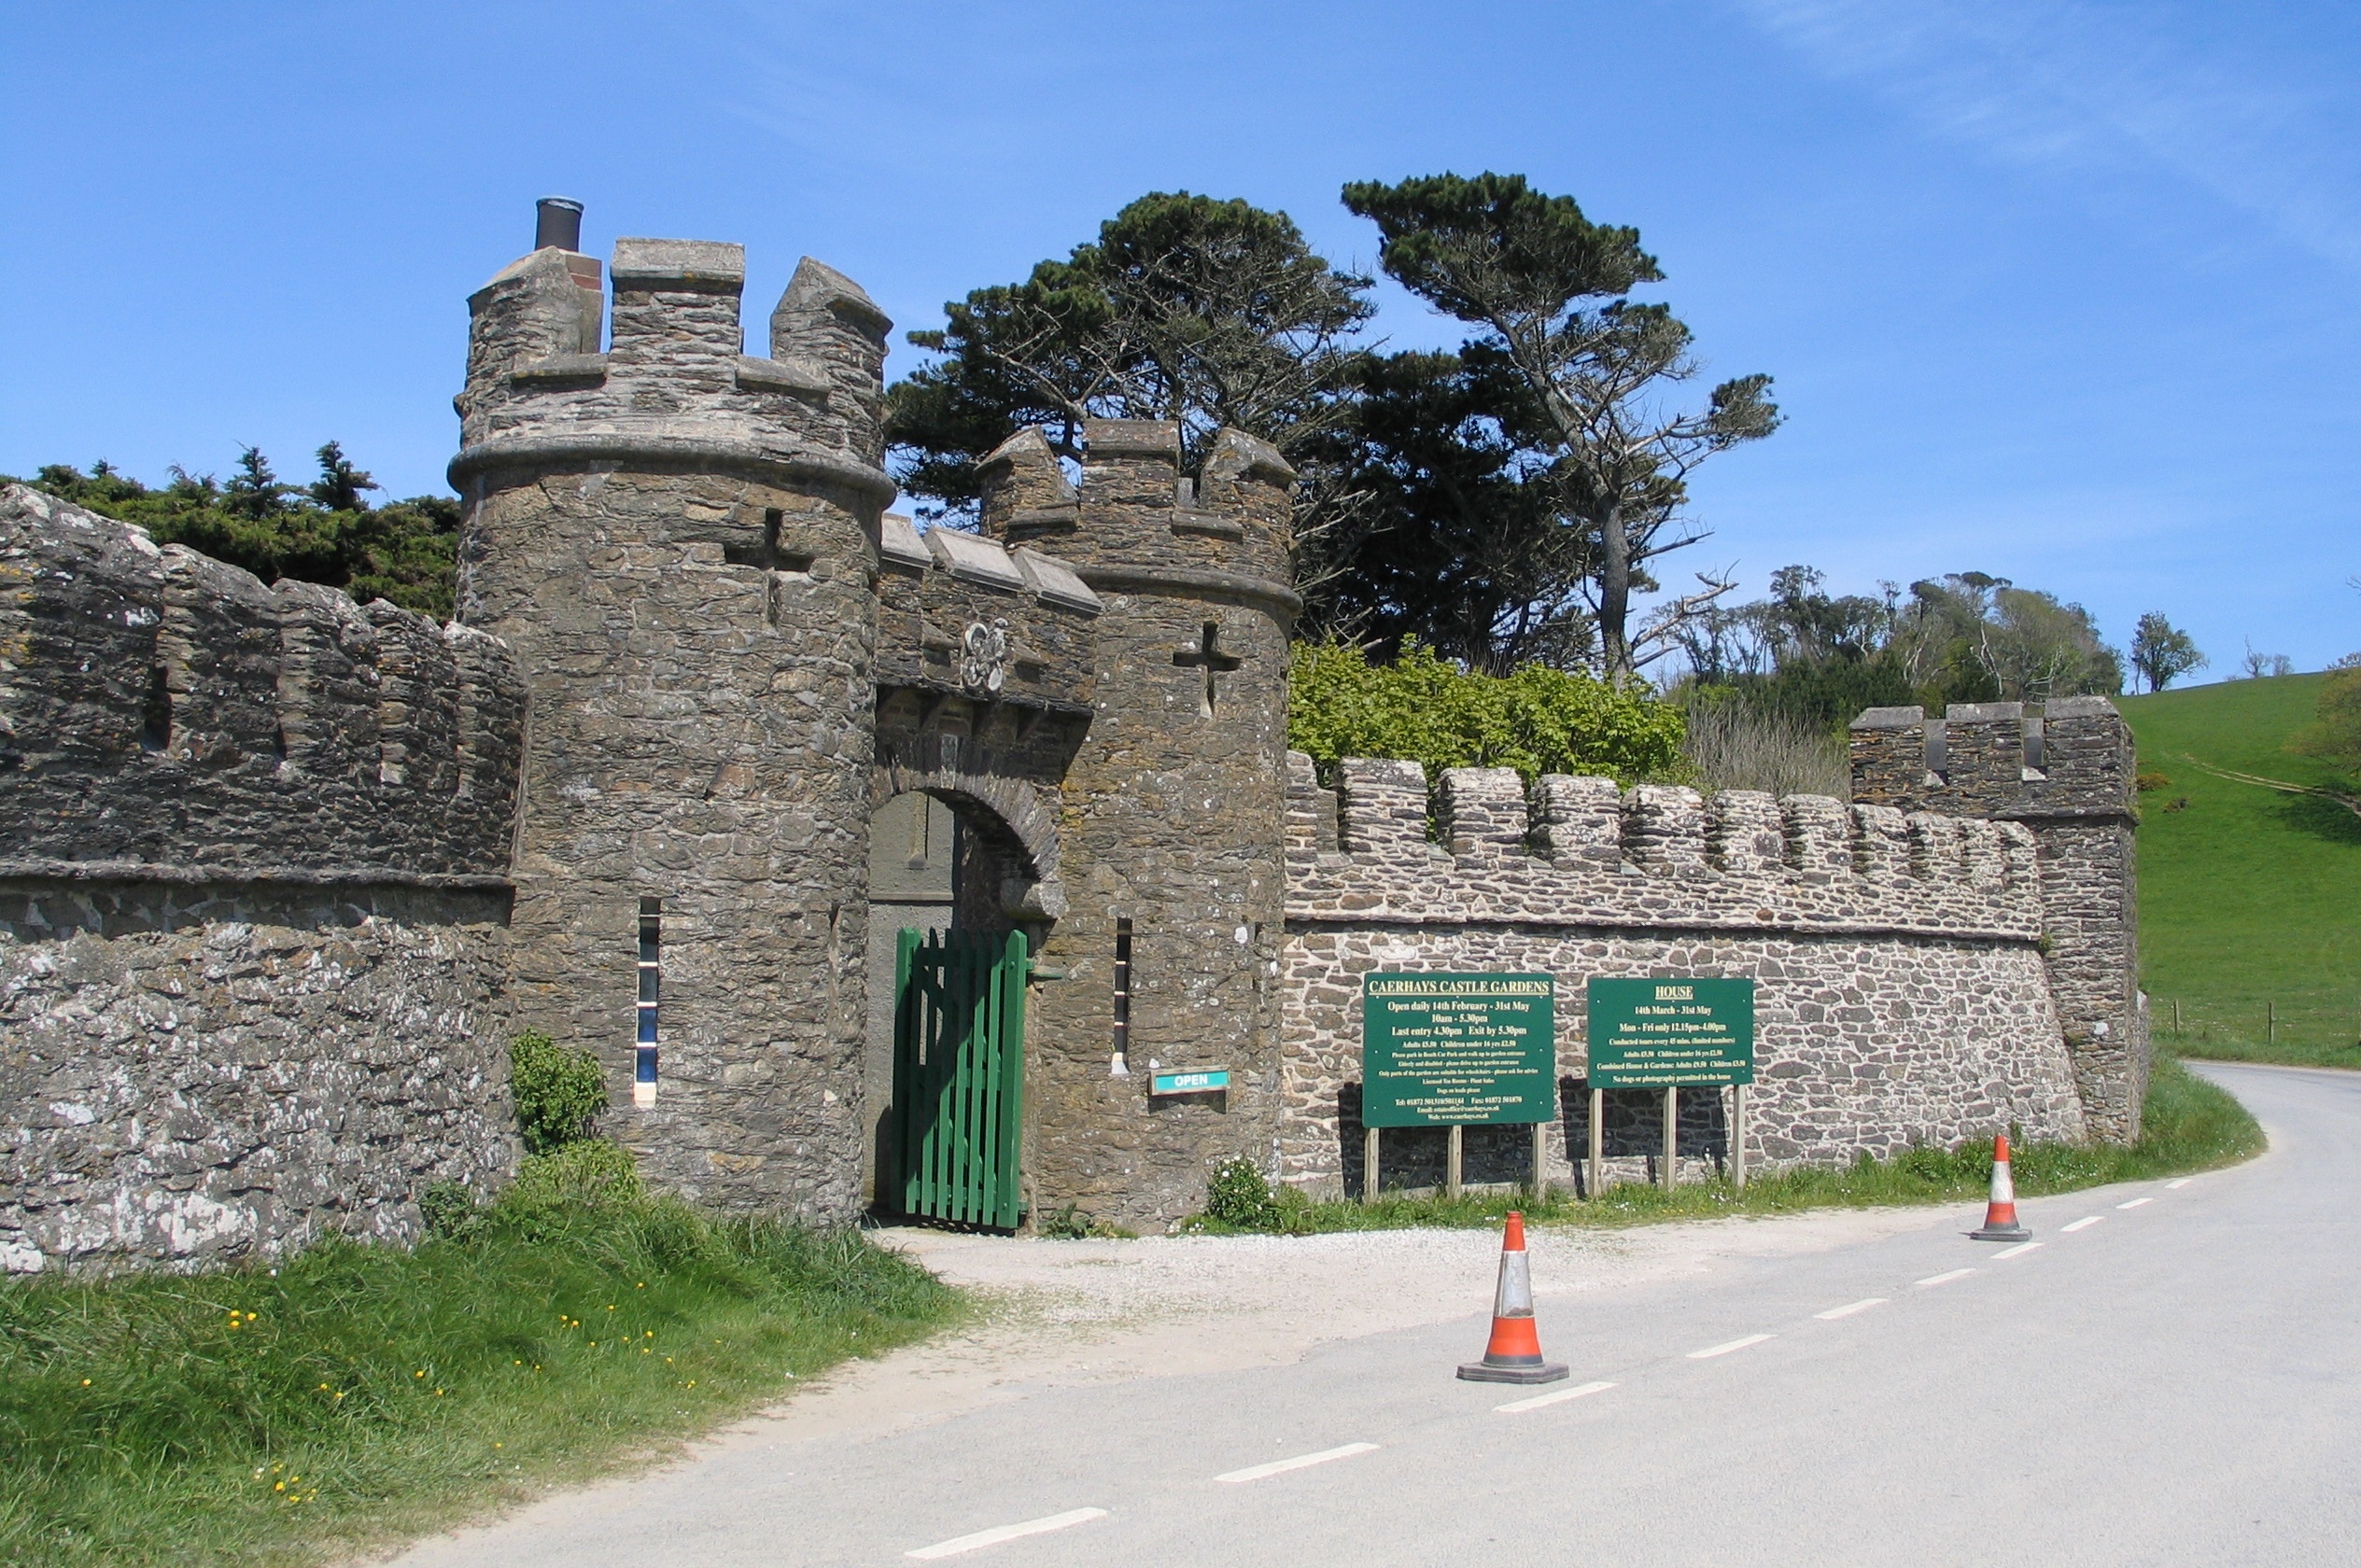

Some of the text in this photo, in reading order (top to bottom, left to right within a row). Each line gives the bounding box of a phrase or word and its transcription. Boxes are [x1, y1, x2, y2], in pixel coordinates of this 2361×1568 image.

[1369, 980, 1550, 993] CAERHAYS CASTLE GARDENS
[1655, 986, 1693, 997] HOUSE
[1387, 1001, 1410, 1013] Open
[1411, 1001, 1430, 1013] daily
[1433, 1001, 1450, 1011] 14th
[1452, 1001, 1488, 1013] February
[1495, 1001, 1511, 1011] 31st
[1512, 1001, 1530, 1013] May
[1635, 1005, 1651, 1015] 14th
[1651, 1005, 1675, 1015] March
[1680, 1005, 1695, 1015] 31st
[1696, 1005, 1712, 1015] May
[1431, 1014, 1453, 1023] 10am
[1458, 1013, 1488, 1025] 5.30pm
[1392, 1025, 1527, 1037] Last entry 4.30pm Exit by 5.30pm
[1619, 1022, 1637, 1032] Mon
[1642, 1022, 1654, 1032] Fri
[1654, 1022, 1670, 1033] only
[1174, 1073, 1208, 1086] OPEN
[1622, 1075, 1635, 1084] dogs
[1642, 1074, 1676, 1084] photography
[1676, 1073, 1702, 1083] permitted
